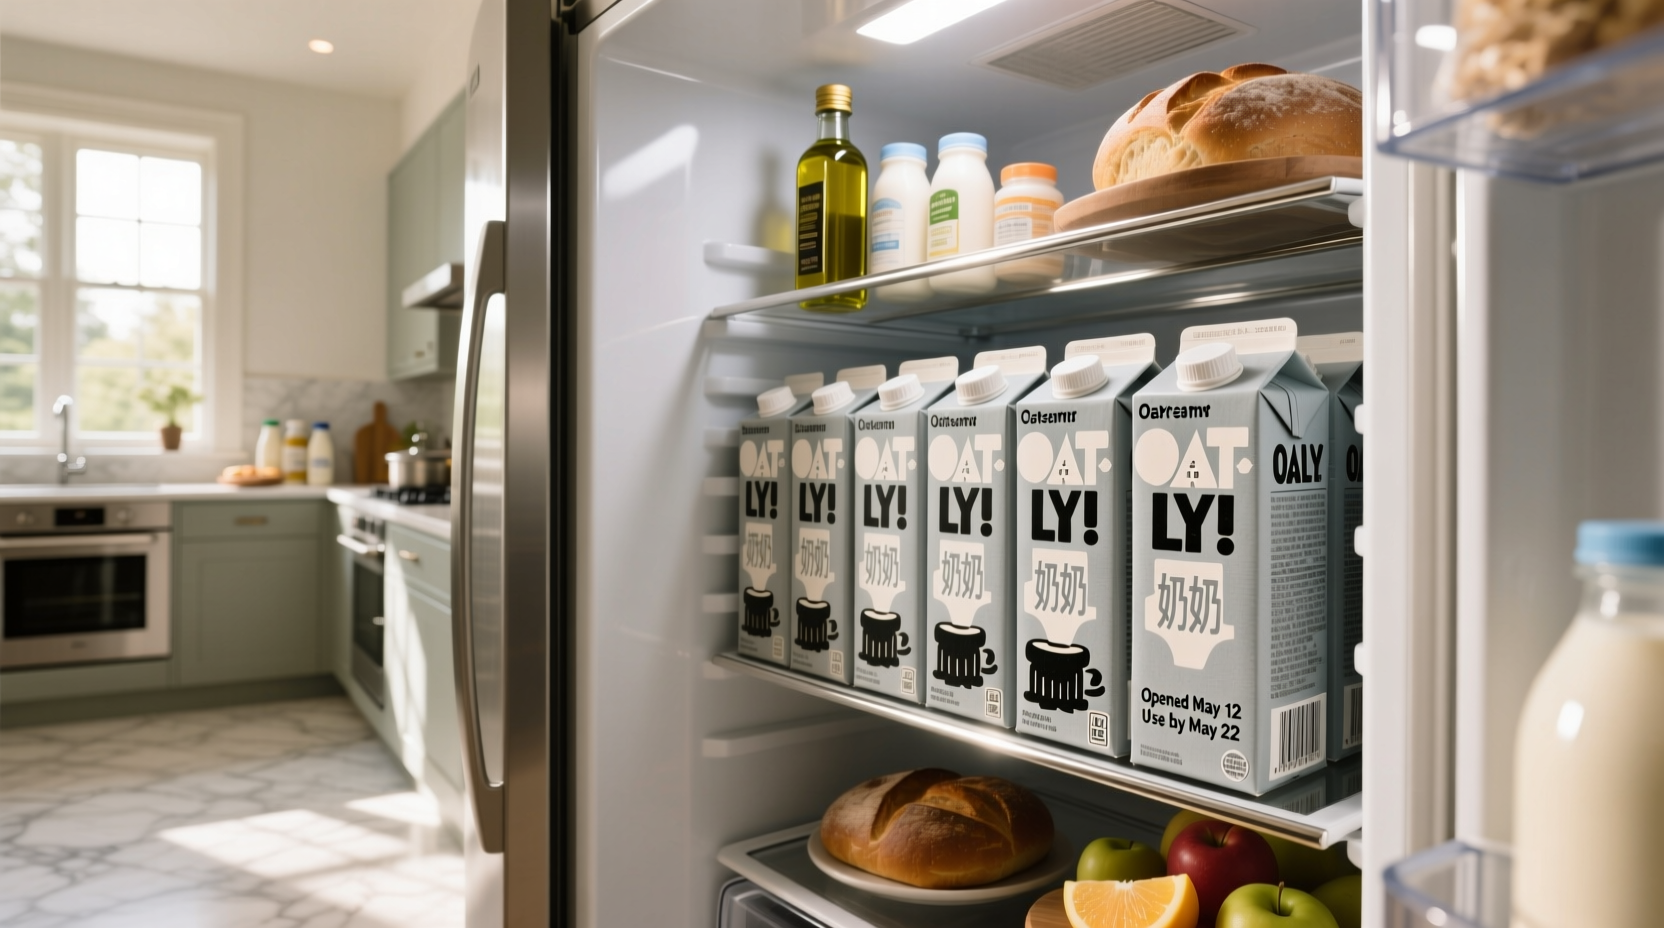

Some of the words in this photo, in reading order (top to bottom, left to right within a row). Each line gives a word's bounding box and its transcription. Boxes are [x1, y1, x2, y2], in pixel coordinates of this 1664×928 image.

[746, 481, 778, 519] LY!
[799, 482, 836, 525] LY!
[864, 484, 907, 530] LY!
[939, 486, 993, 537] LY!
[1031, 489, 1099, 546] LY!
[1152, 492, 1235, 556] LY!
[941, 551, 984, 600] 奶奶
[1034, 560, 1087, 616] 奶奶
[1157, 572, 1222, 635] 奶奶
[1141, 687, 1189, 708] Opened
[1193, 695, 1221, 719] May
[1224, 703, 1242, 720] 12
[1142, 708, 1165, 727] Use
[1169, 712, 1186, 735] by
[1189, 716, 1218, 741] May
[1220, 723, 1240, 742] 22
